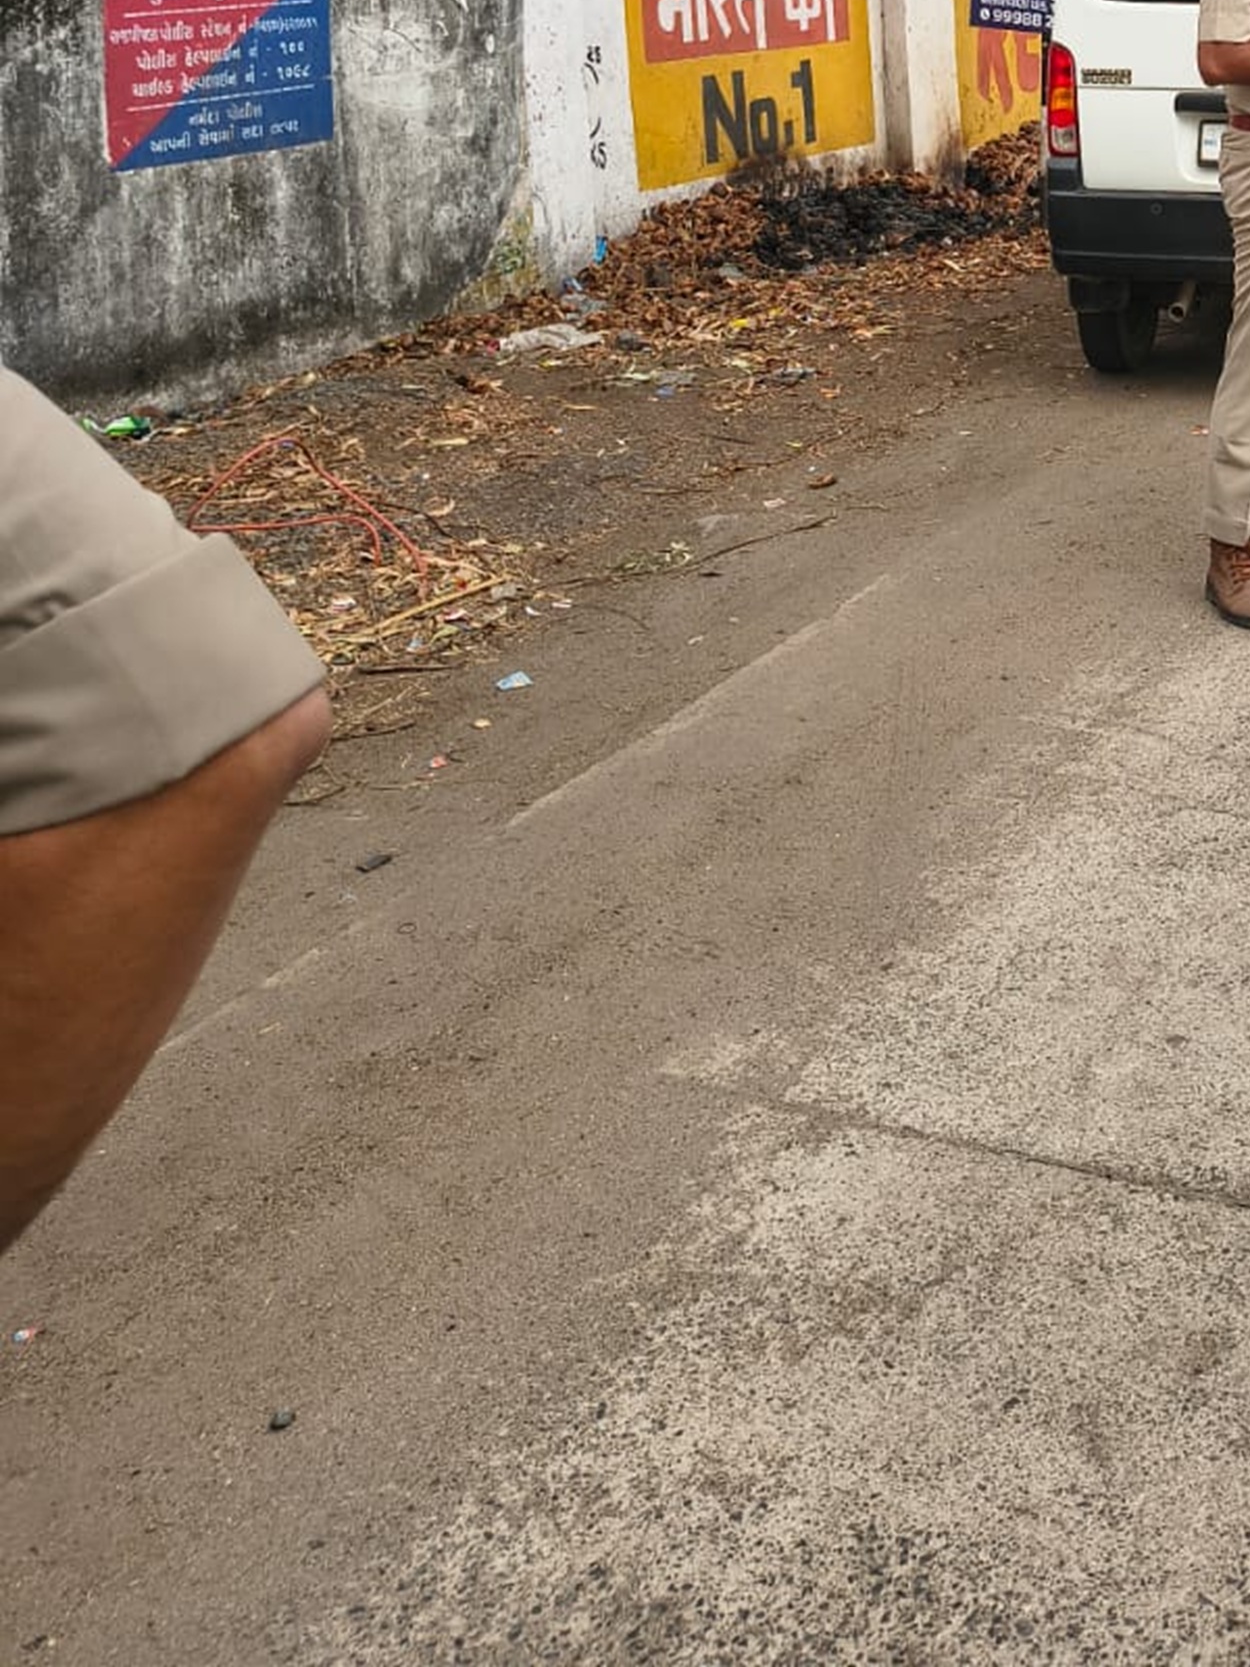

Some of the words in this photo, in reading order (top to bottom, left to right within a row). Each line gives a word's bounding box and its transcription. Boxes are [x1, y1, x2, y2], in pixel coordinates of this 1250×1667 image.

[992, 8, 1042, 28] 99988
[136, 48, 177, 70] પોલીસ
[150, 131, 191, 153] આપની
